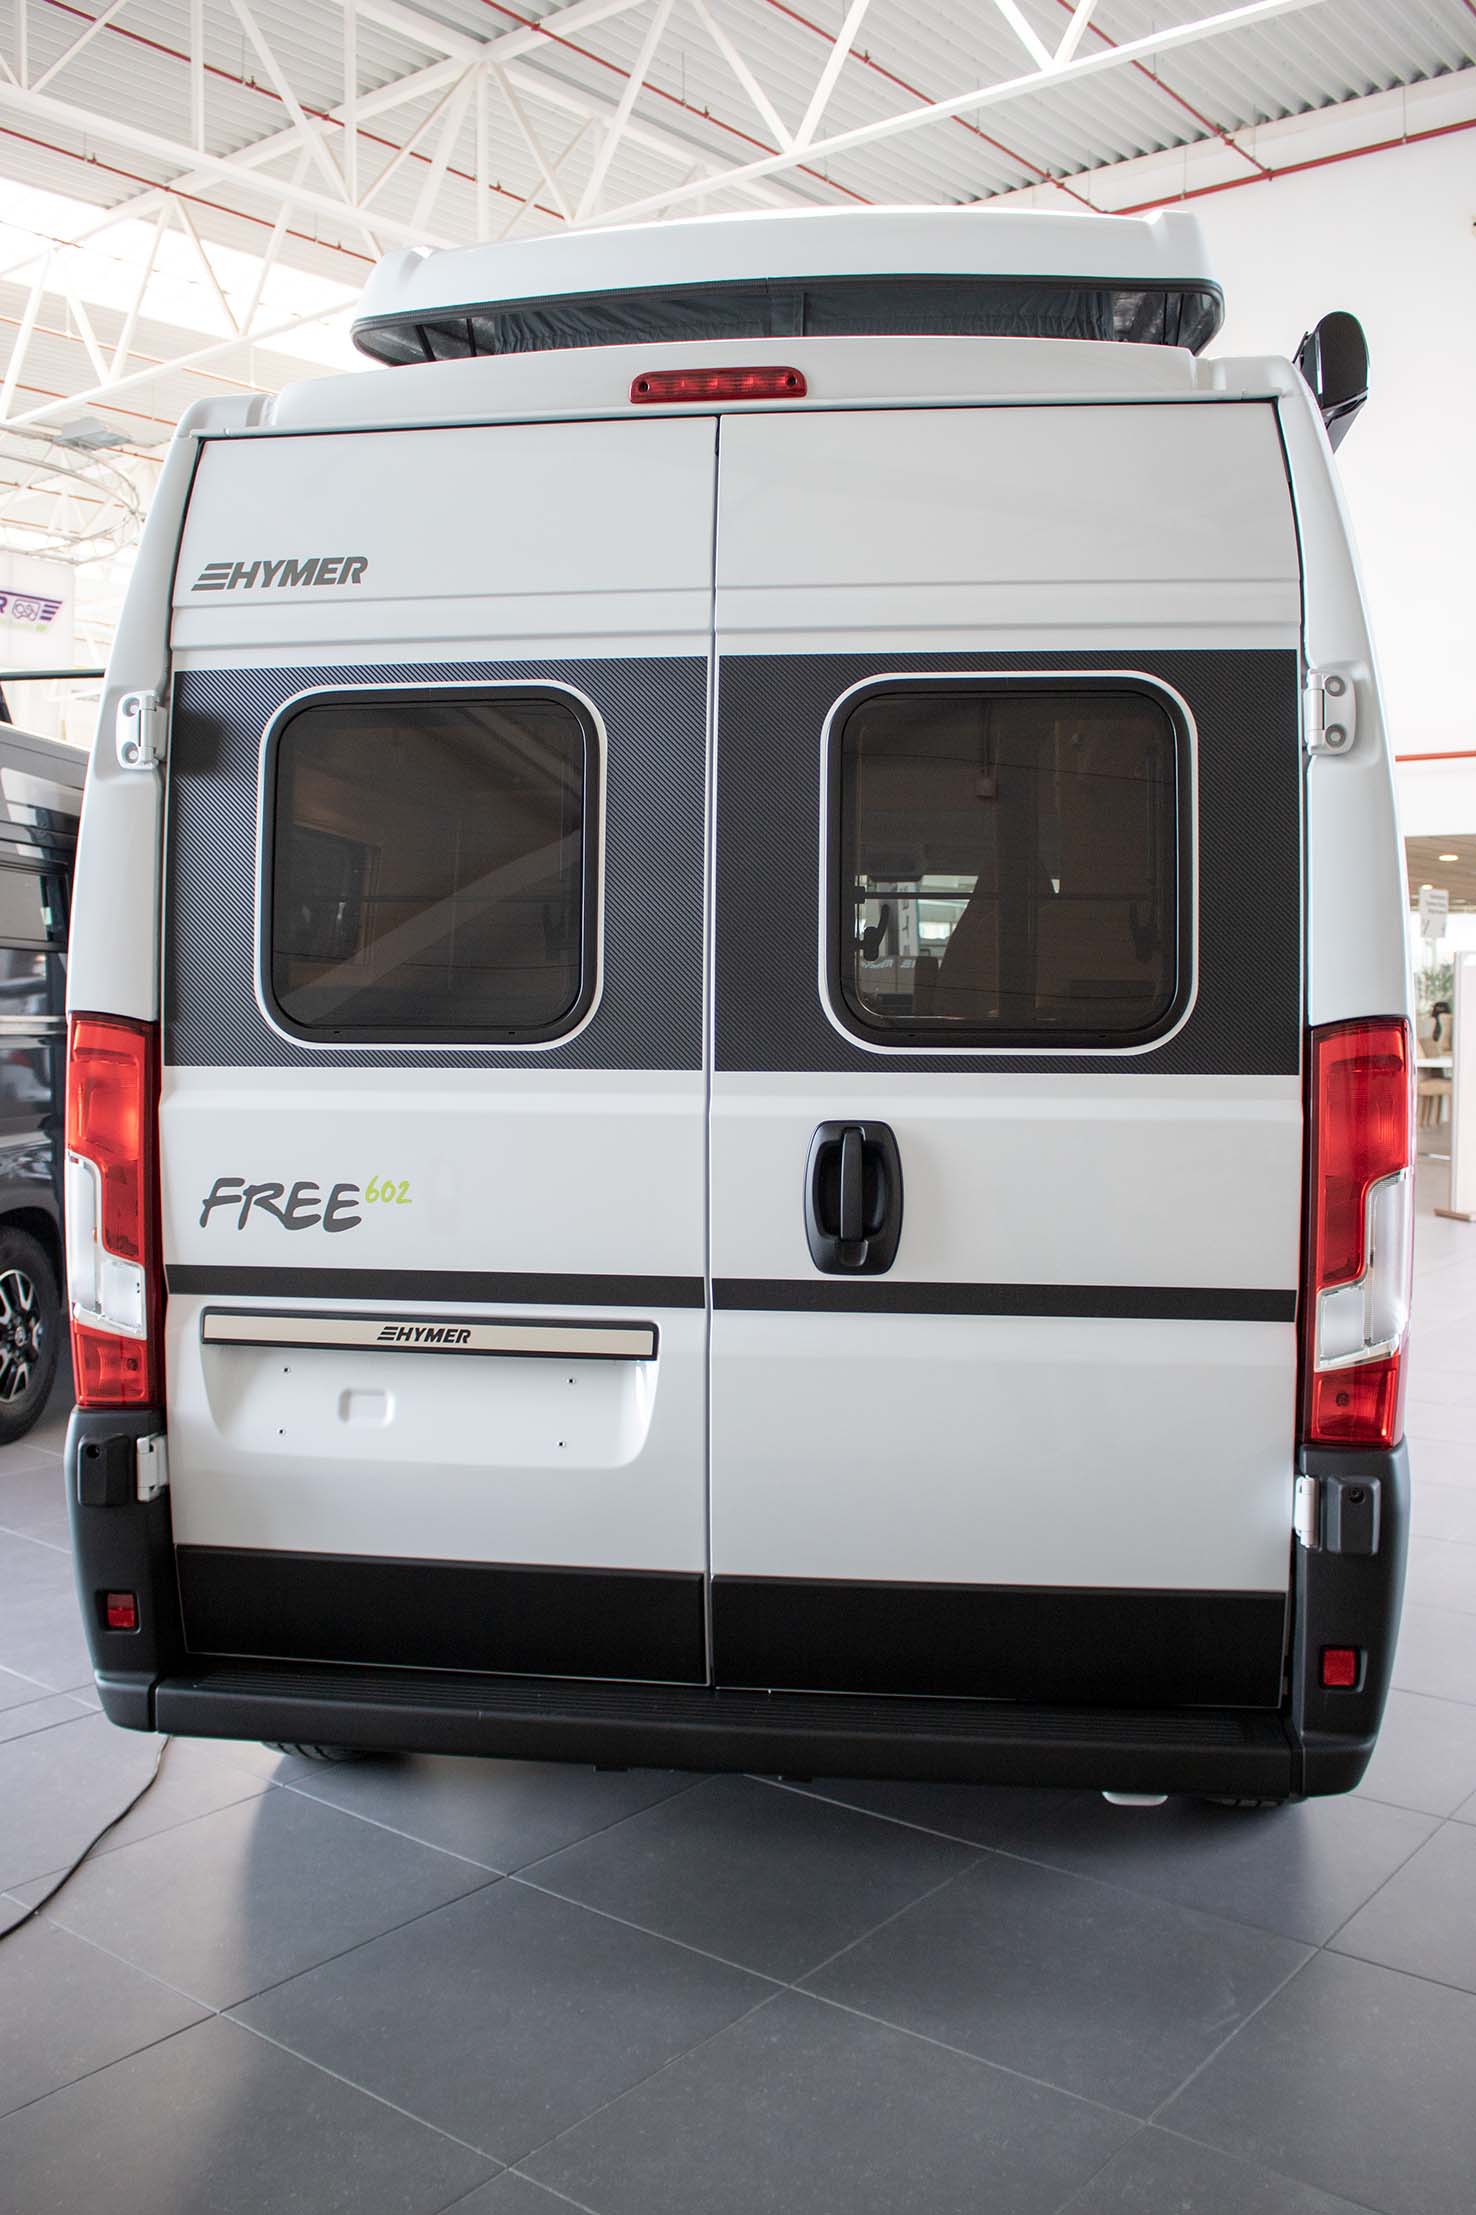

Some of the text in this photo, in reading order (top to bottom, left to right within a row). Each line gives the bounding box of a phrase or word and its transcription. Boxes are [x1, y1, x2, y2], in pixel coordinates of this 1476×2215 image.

[226, 556, 369, 590] HYMER
[199, 1175, 413, 1233] FREE 602
[395, 1326, 472, 1344] HYMER
